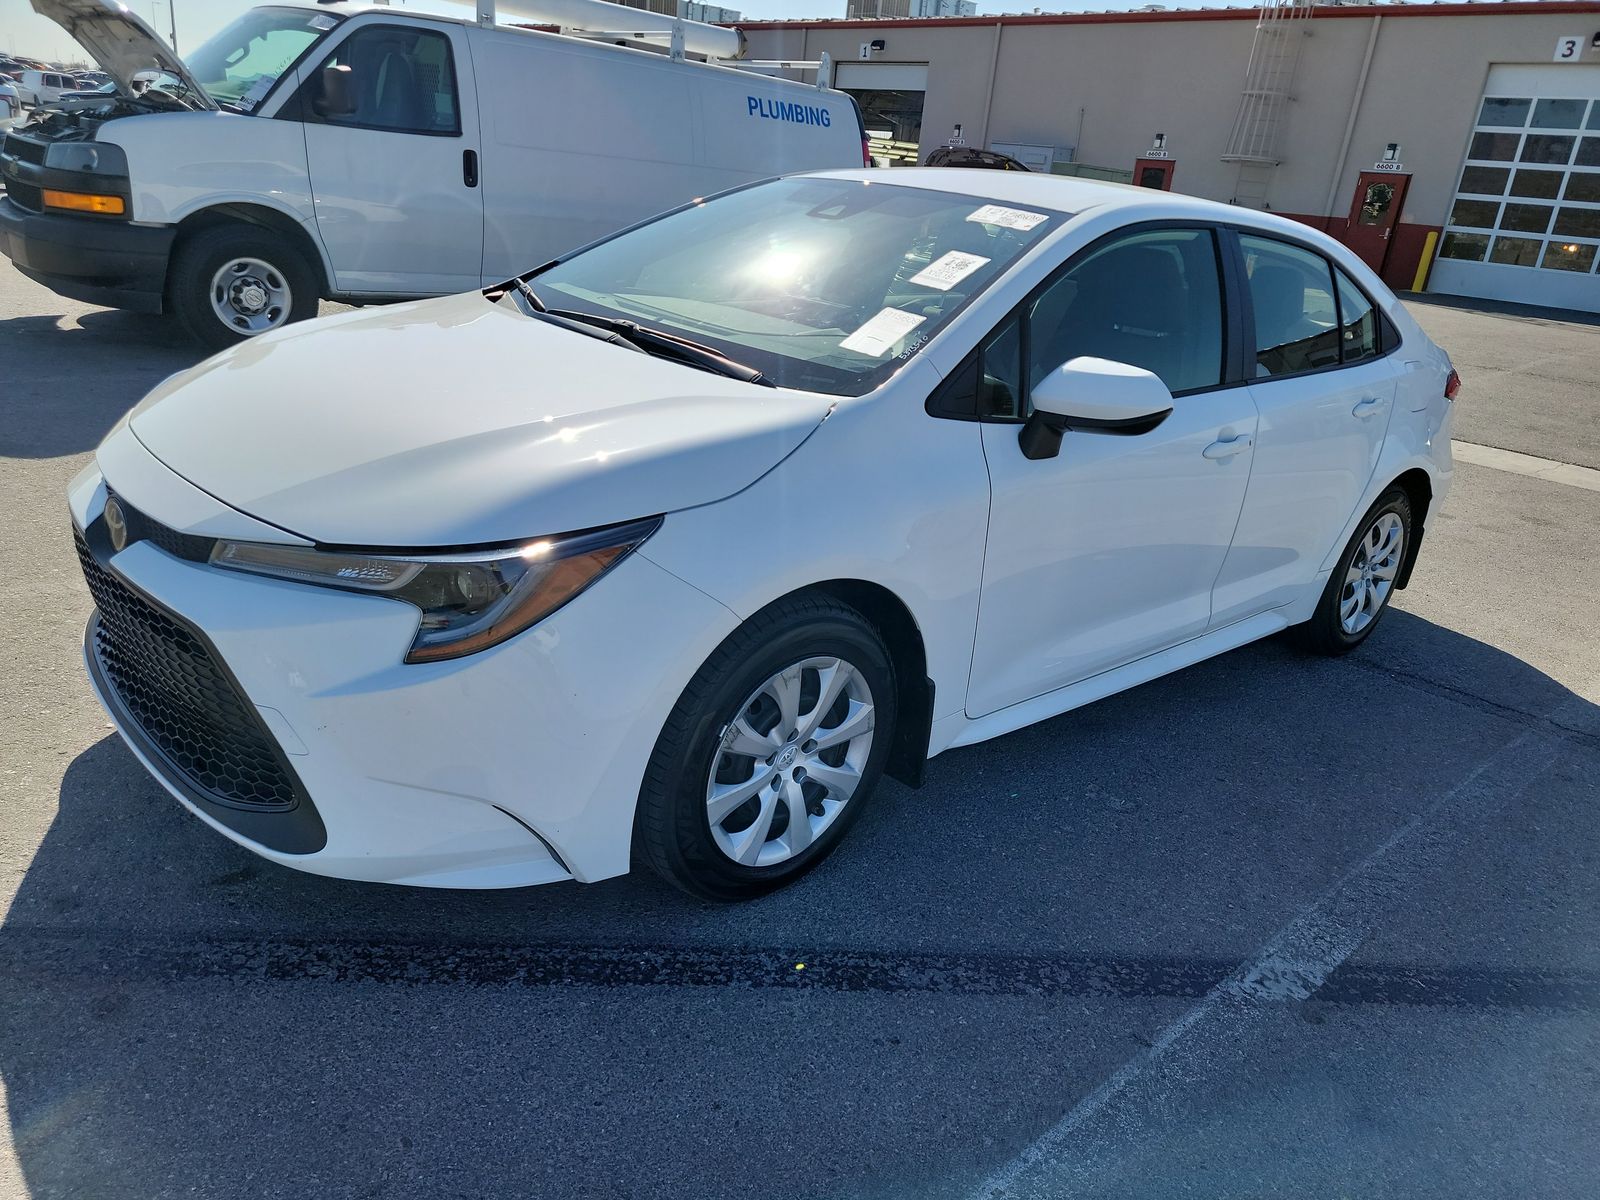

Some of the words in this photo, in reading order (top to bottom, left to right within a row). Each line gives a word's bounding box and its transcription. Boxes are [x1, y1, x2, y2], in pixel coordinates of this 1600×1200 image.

[862, 46, 868, 58] 1
[1561, 40, 1576, 58] 3
[747, 96, 831, 127] PLUMBING
